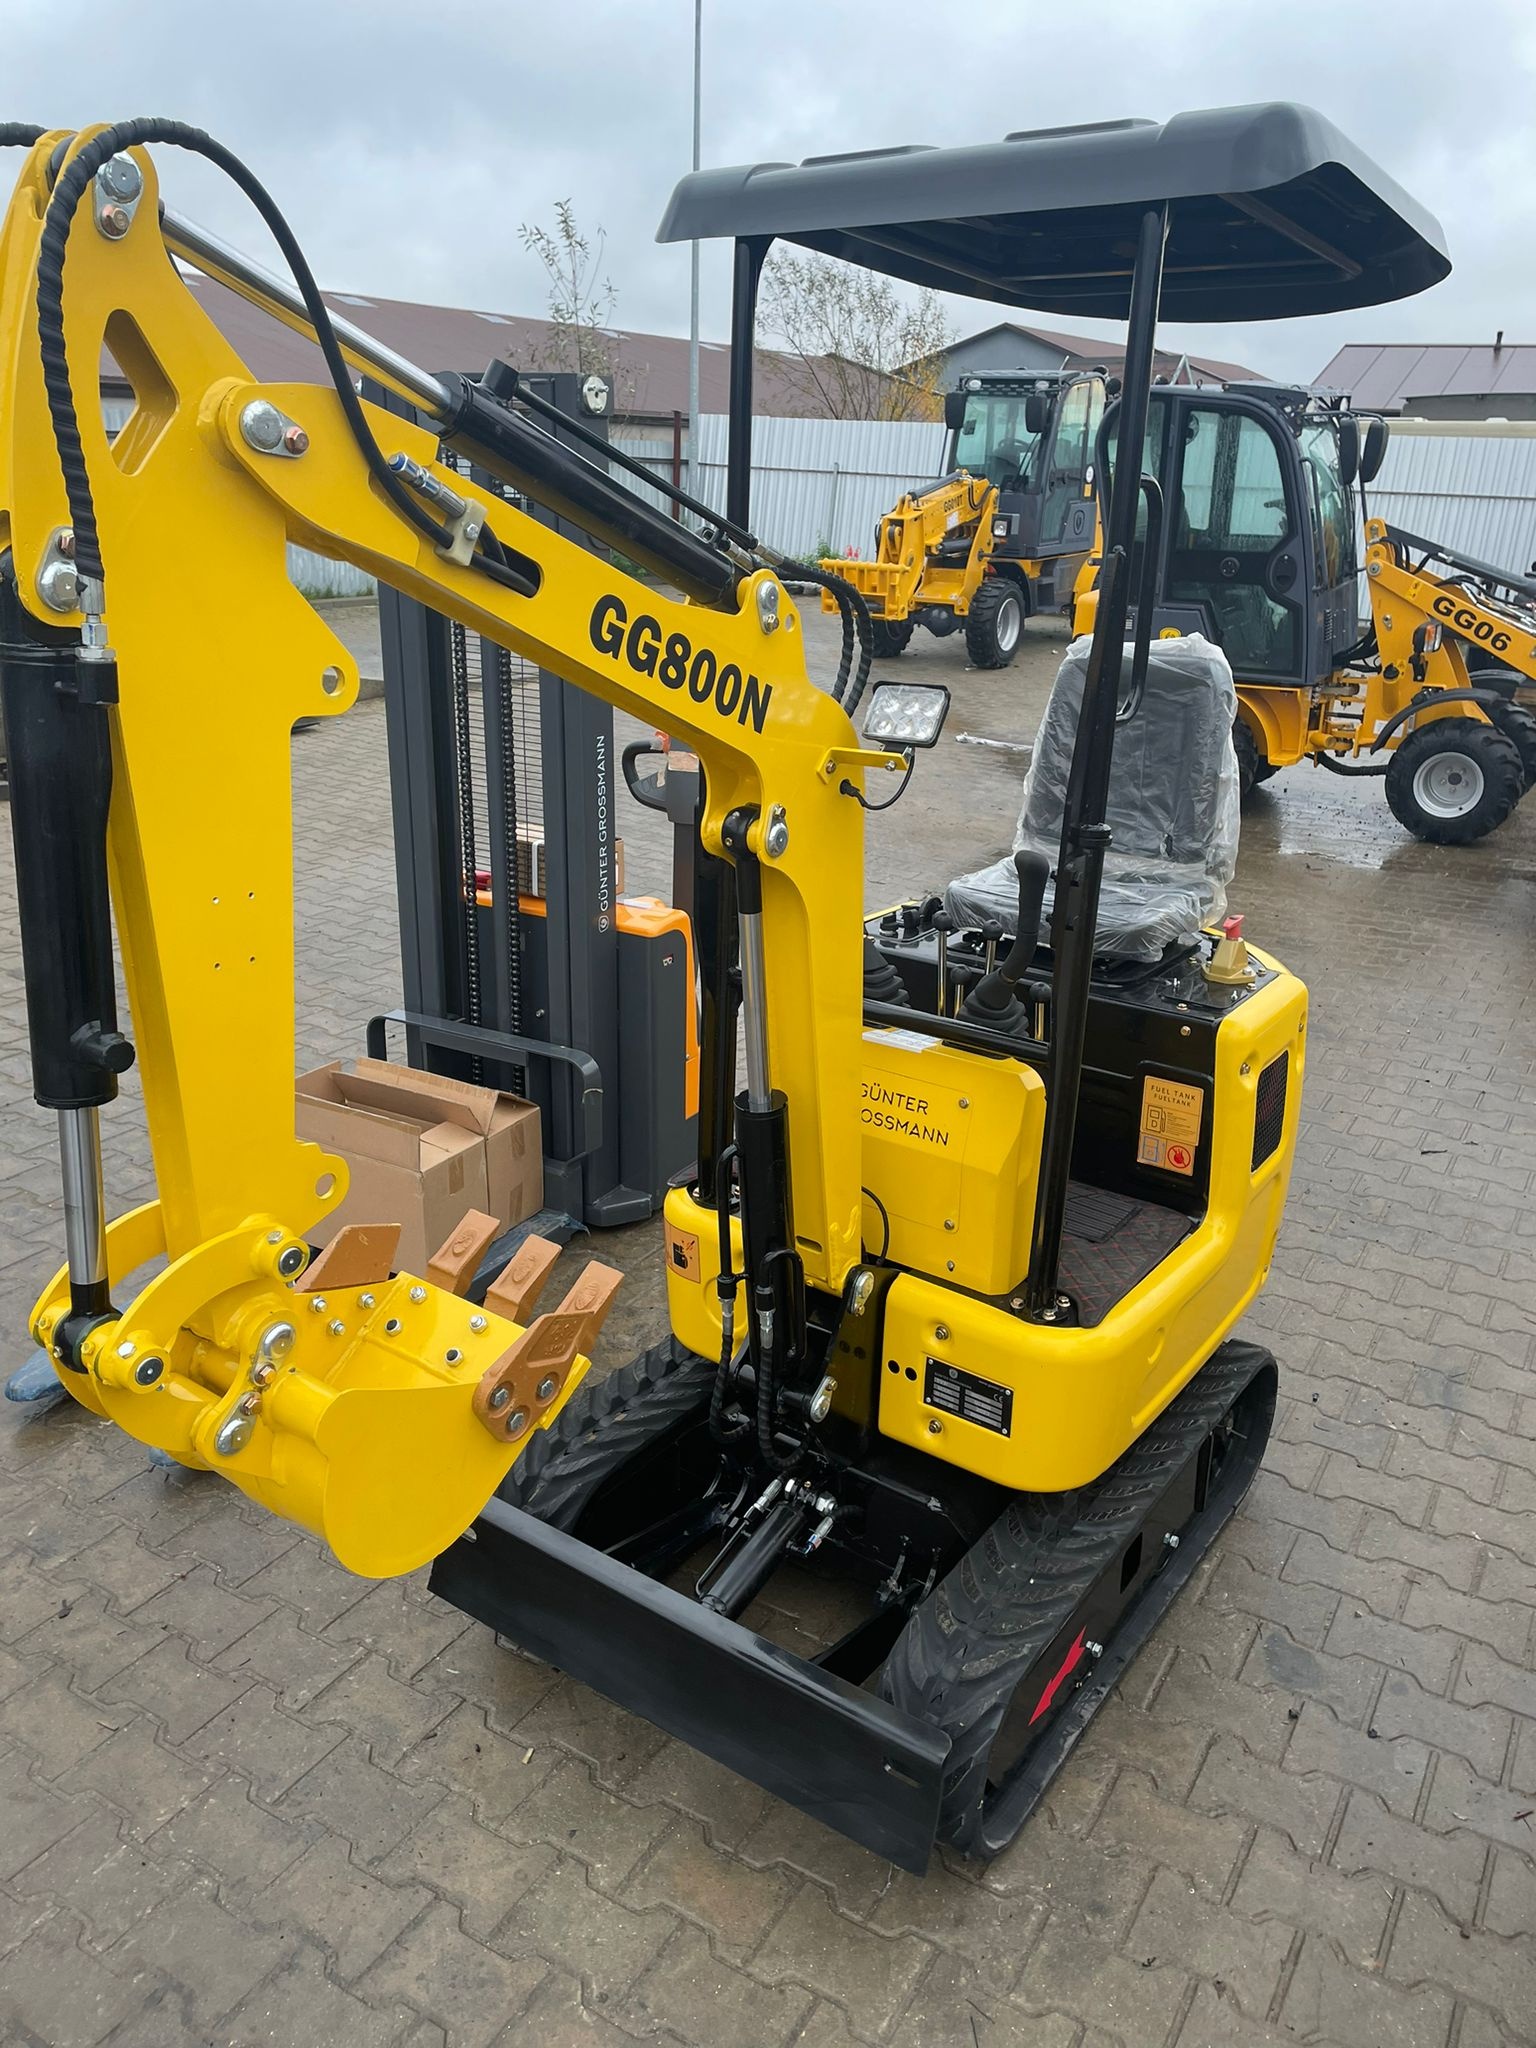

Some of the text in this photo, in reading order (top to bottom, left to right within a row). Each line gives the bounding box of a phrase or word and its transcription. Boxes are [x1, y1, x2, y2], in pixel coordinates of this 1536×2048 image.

[1433, 596, 1512, 651] GG06
[589, 594, 773, 734] GG800N
[597, 735, 609, 911] GÜNTER GROSSMANN
[1151, 1085, 1196, 1101] FUEL TANK
[861, 1108, 949, 1146] OSSMANN
